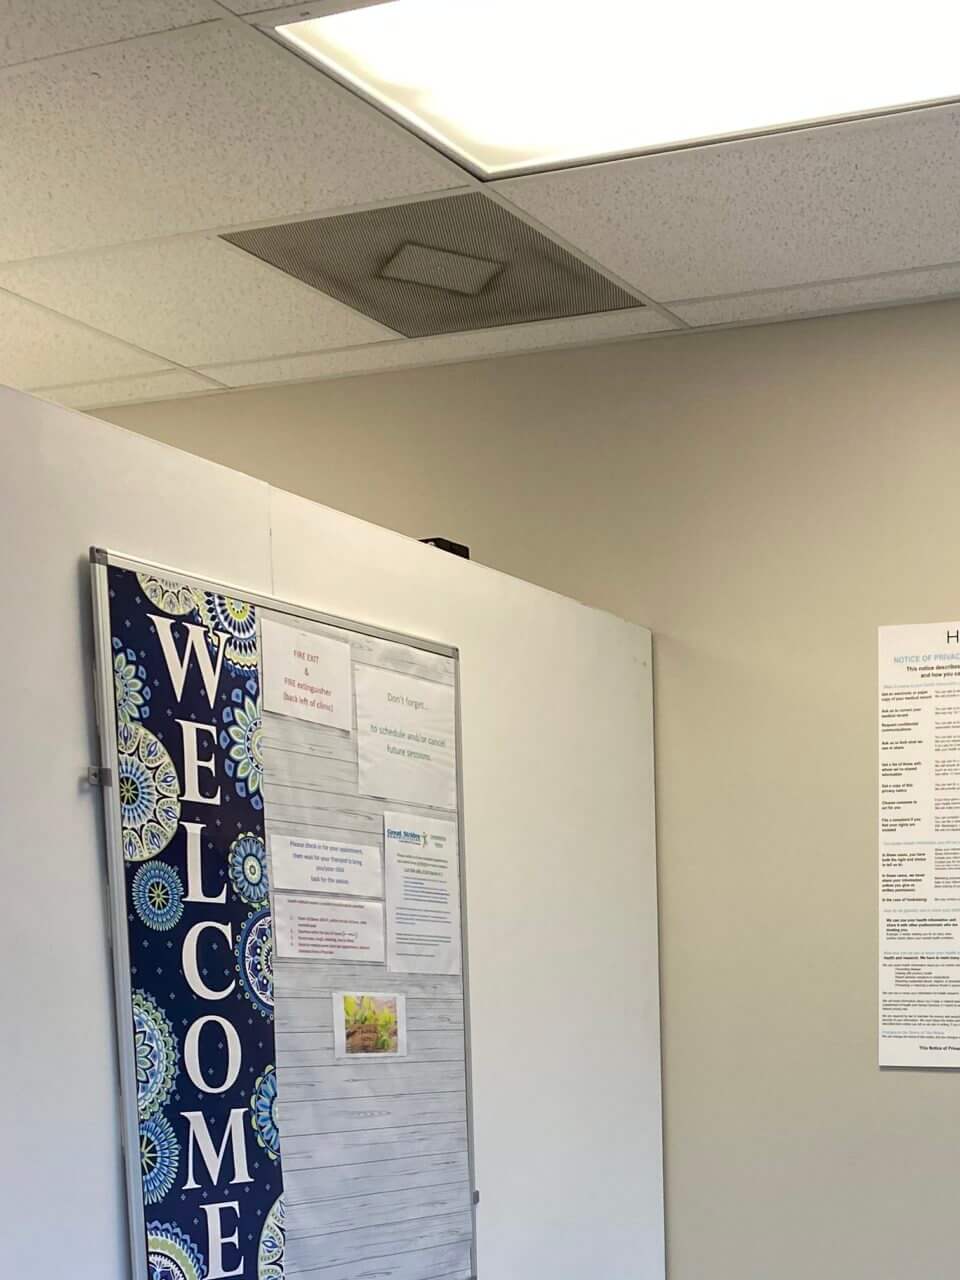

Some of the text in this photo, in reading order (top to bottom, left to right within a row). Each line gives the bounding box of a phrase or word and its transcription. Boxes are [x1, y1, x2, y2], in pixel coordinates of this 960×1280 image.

[307, 654, 319, 664] EXIT
[894, 655, 920, 663] NOTICE
[922, 654, 931, 662] OF
[297, 682, 332, 697] extinguisher
[379, 727, 406, 739] schedule
[147, 612, 254, 1280] WELCOME
